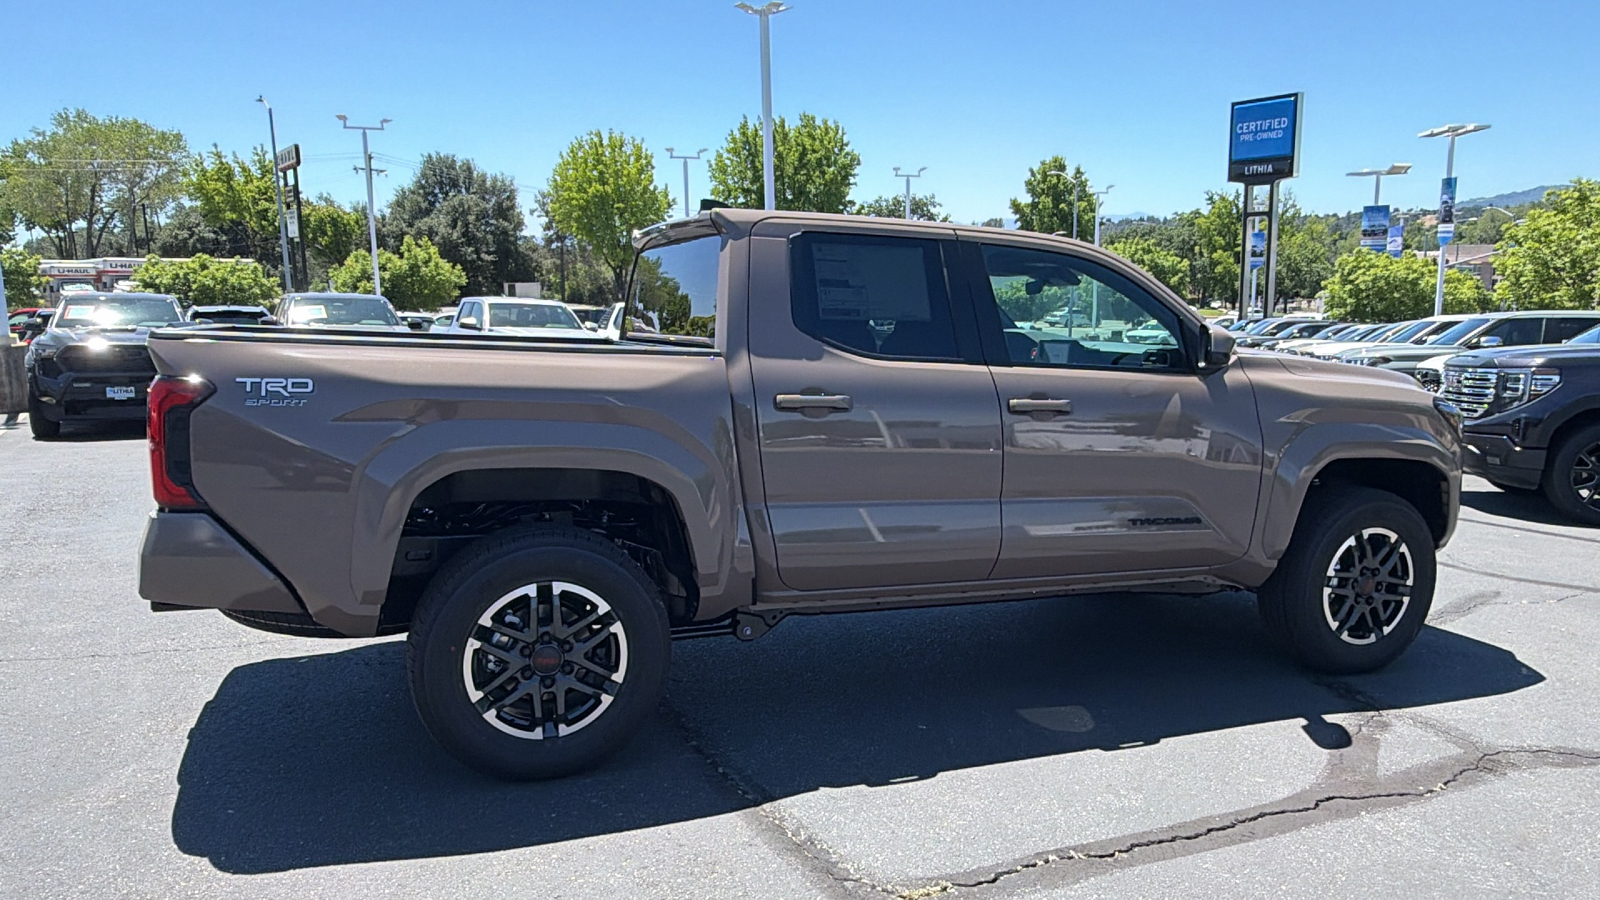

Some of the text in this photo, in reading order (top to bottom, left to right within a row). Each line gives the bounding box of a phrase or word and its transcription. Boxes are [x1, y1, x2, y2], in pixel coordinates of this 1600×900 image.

[1236, 117, 1288, 134] CERTIFIED
[1240, 130, 1283, 142] PRE-OWNED
[1244, 164, 1273, 175] LITHIA
[235, 377, 314, 397] TRD
[244, 398, 308, 407] SPORT
